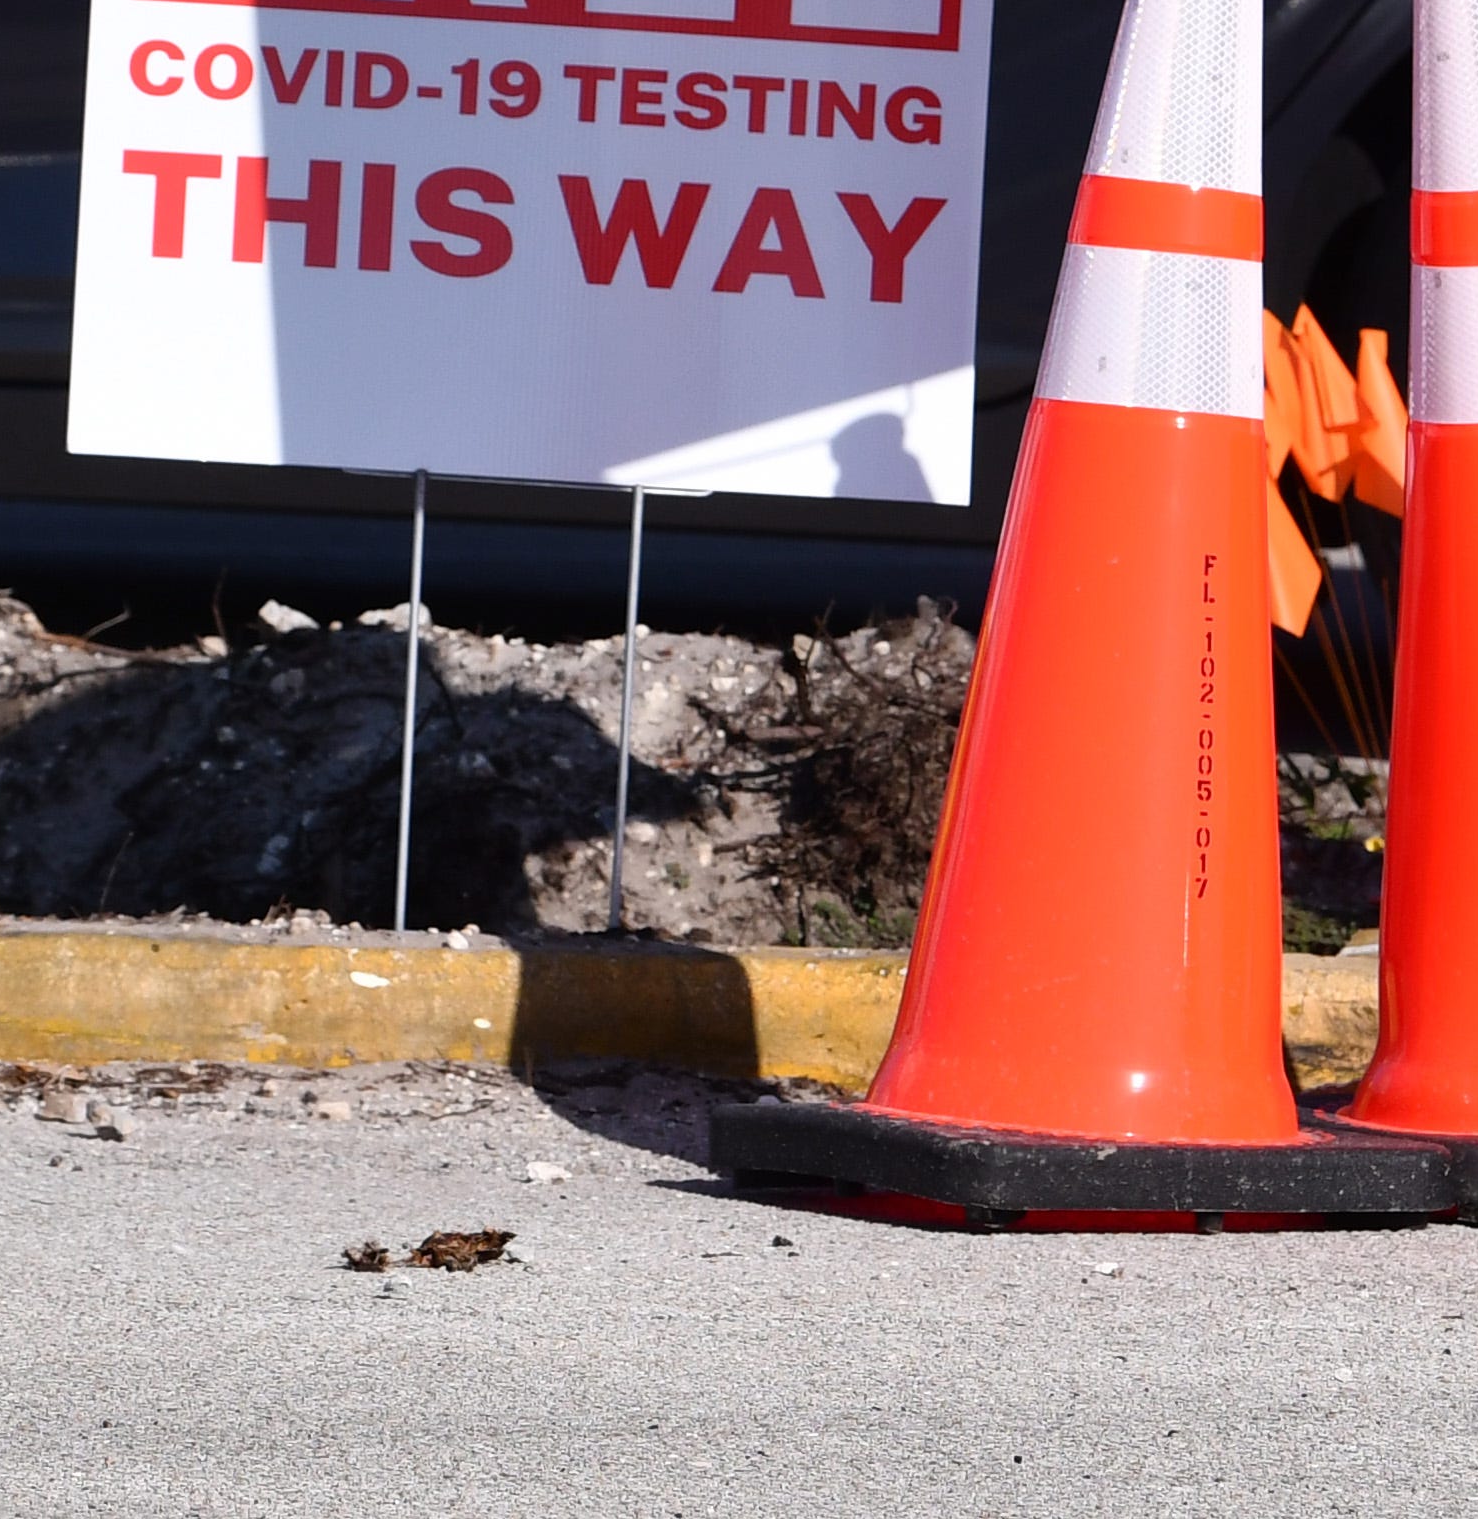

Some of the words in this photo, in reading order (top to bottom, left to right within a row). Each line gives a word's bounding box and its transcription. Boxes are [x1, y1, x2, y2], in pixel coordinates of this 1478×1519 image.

[128, 38, 542, 119] COVID-19
[563, 64, 943, 146] TESTING
[121, 147, 515, 278] THIS
[556, 173, 948, 304] WAY
[1194, 553, 1219, 900] FL-102-005-017
